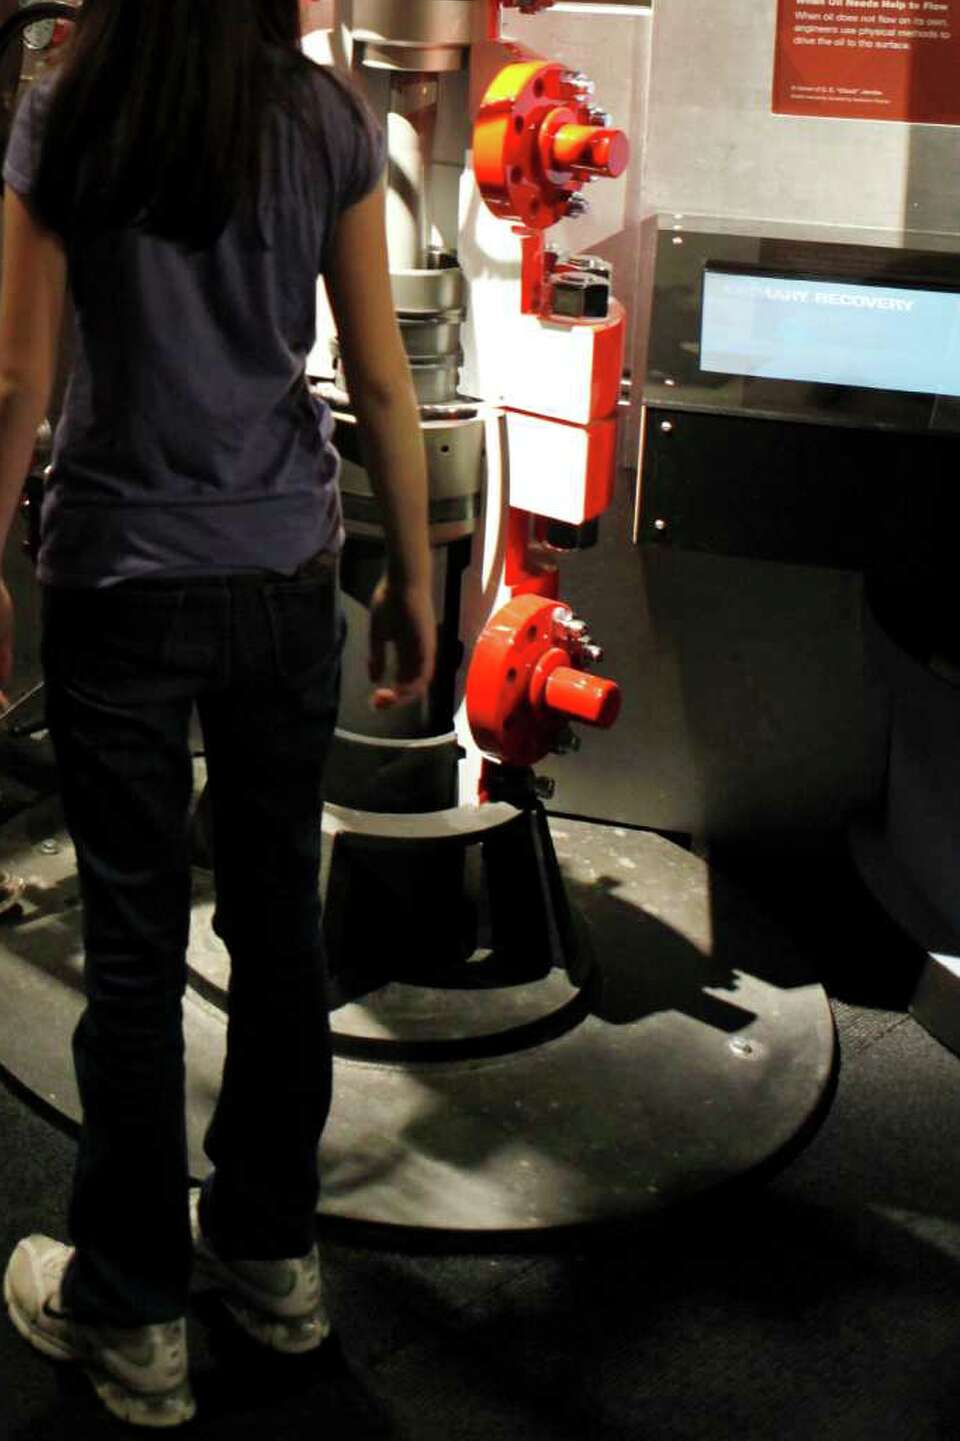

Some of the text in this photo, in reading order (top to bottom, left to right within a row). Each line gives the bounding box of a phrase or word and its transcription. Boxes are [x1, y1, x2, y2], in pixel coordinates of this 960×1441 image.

[845, 0, 879, 8] Needs
[882, 1, 906, 11] Help
[909, 2, 920, 10] to
[923, 2, 948, 11] Flow
[795, 11, 822, 21] When
[814, 292, 913, 311] RECOVERY
